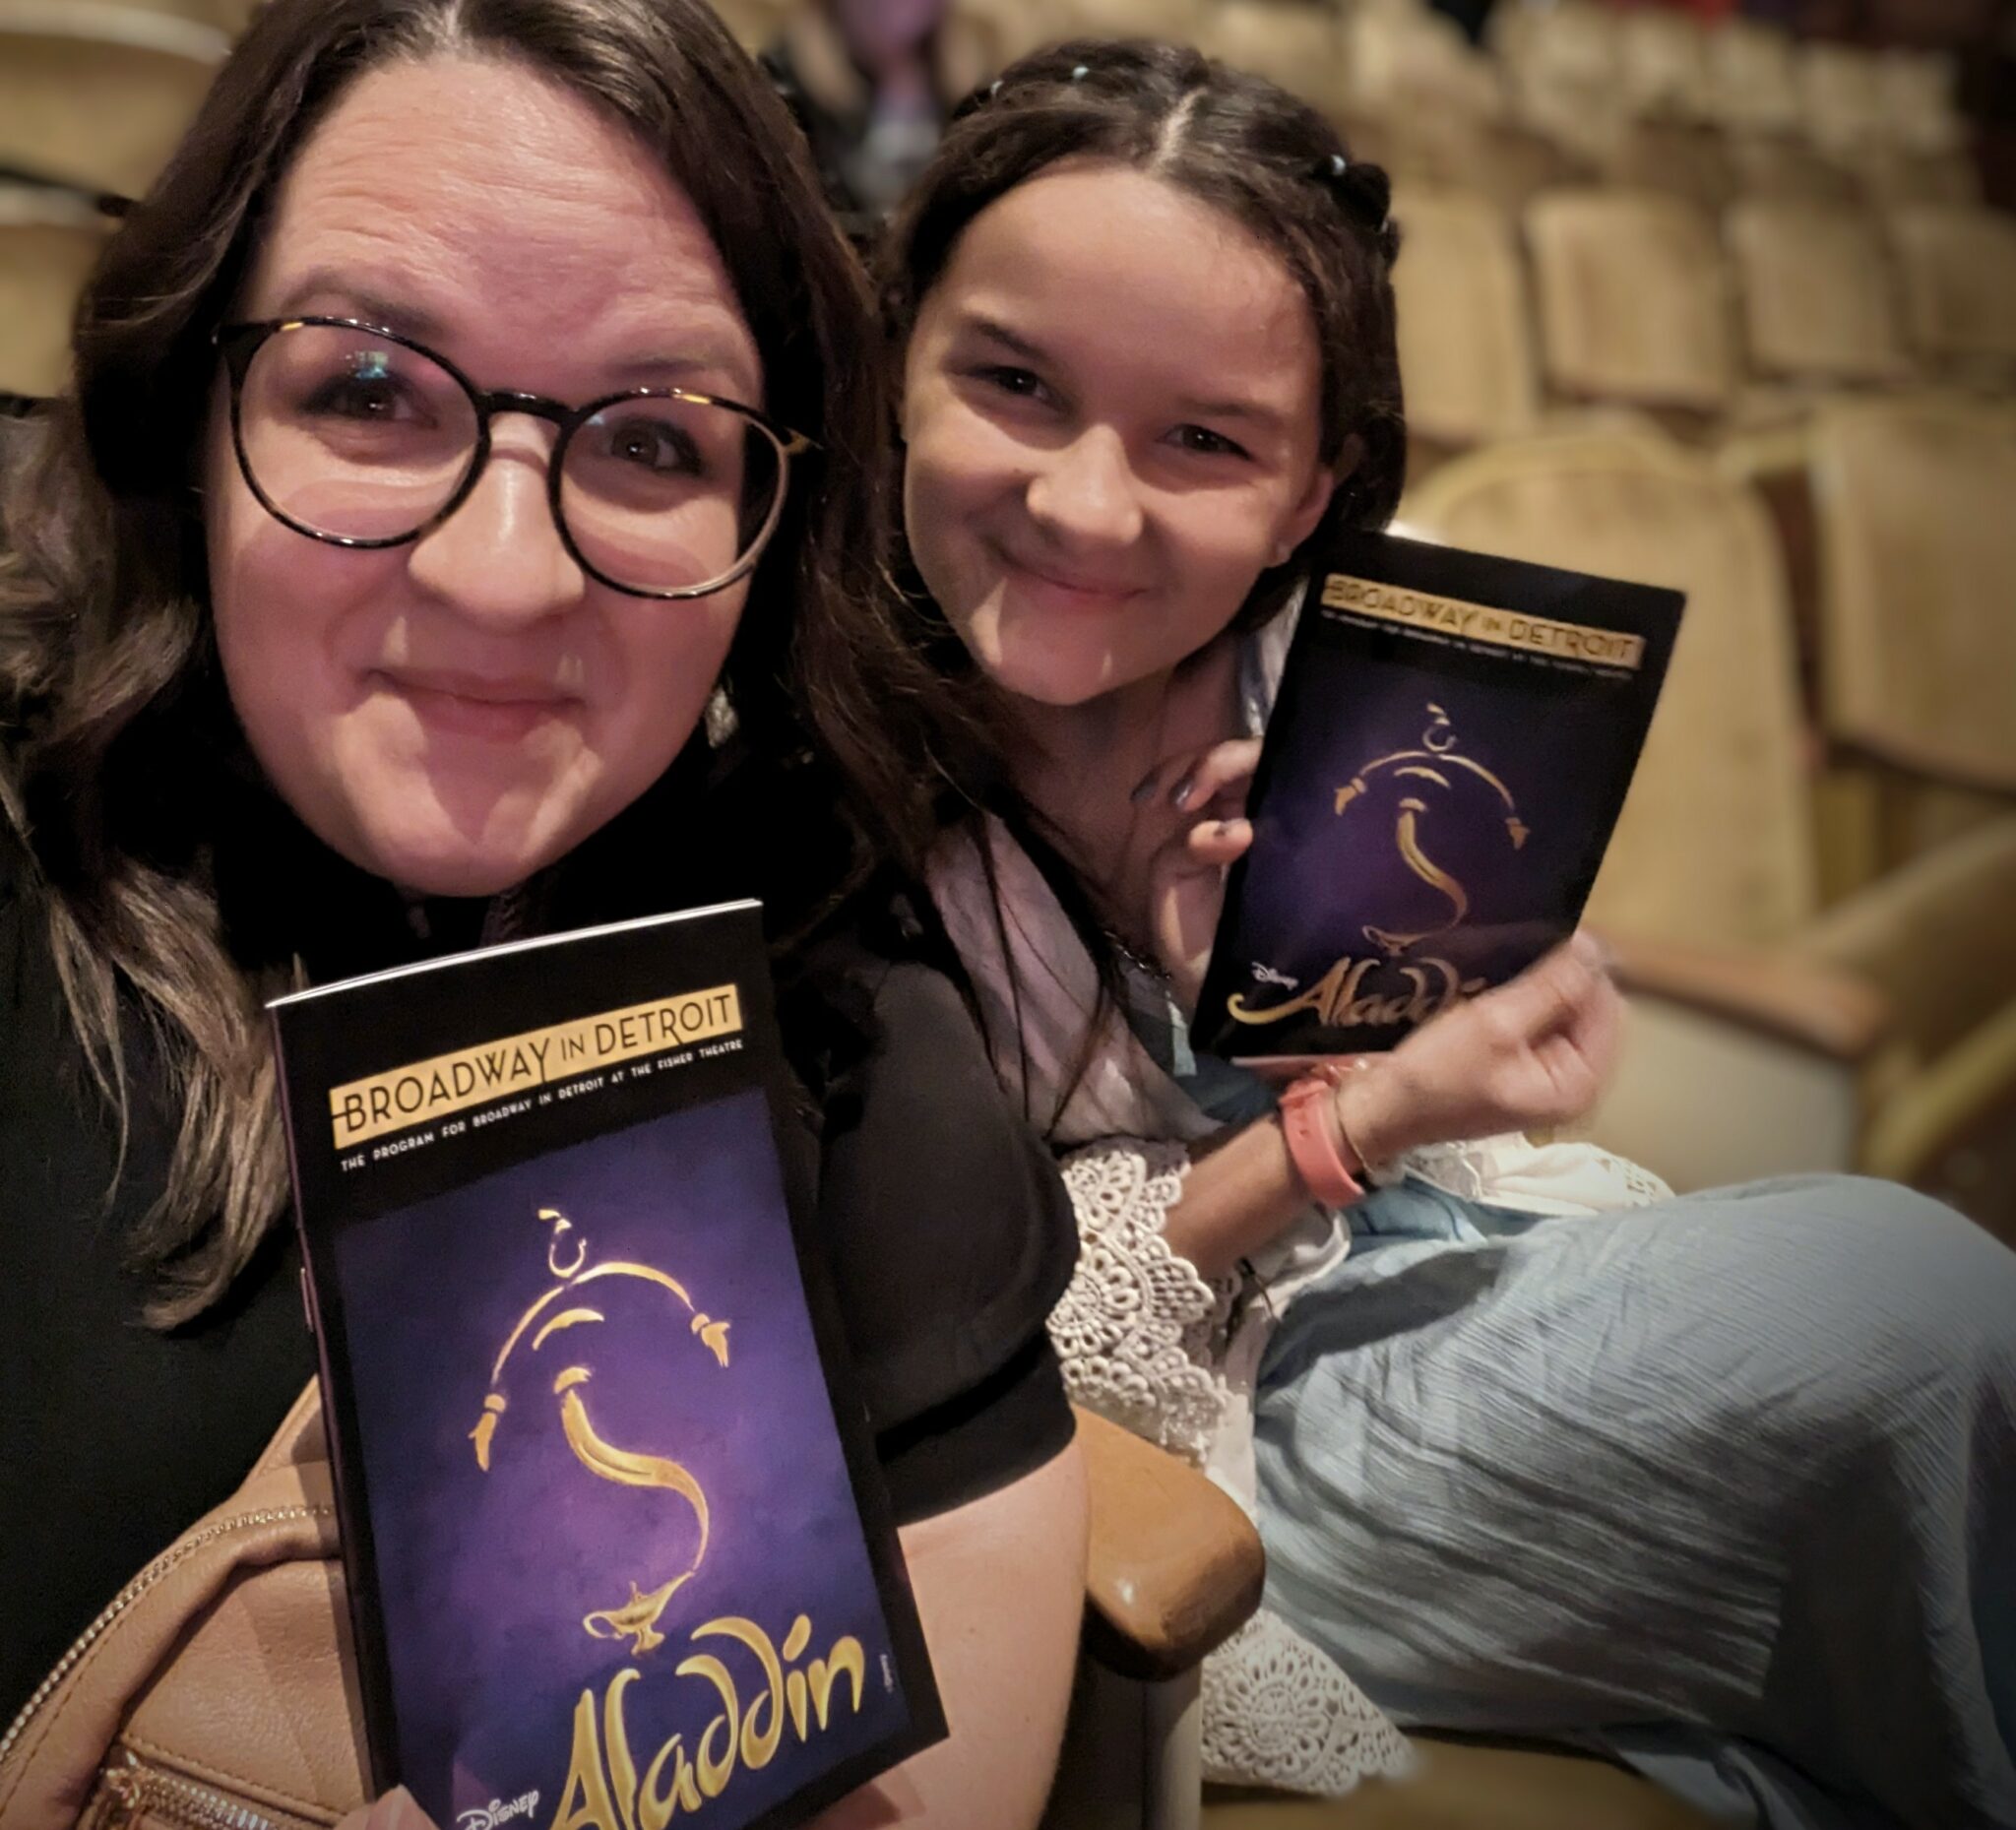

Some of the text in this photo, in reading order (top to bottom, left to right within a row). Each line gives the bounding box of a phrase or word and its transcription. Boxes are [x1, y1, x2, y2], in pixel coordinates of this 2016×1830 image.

[1324, 577, 1474, 638] BROADWAY
[1508, 618, 1634, 660] DETROIT
[333, 993, 732, 1133] BROADWAY IN DETROIT
[341, 1039, 743, 1171] THE PROGRAM FOR BROADWAY IN DETROIT AT THE FISHER THEATRE
[549, 1613, 866, 1830] Aladdin
